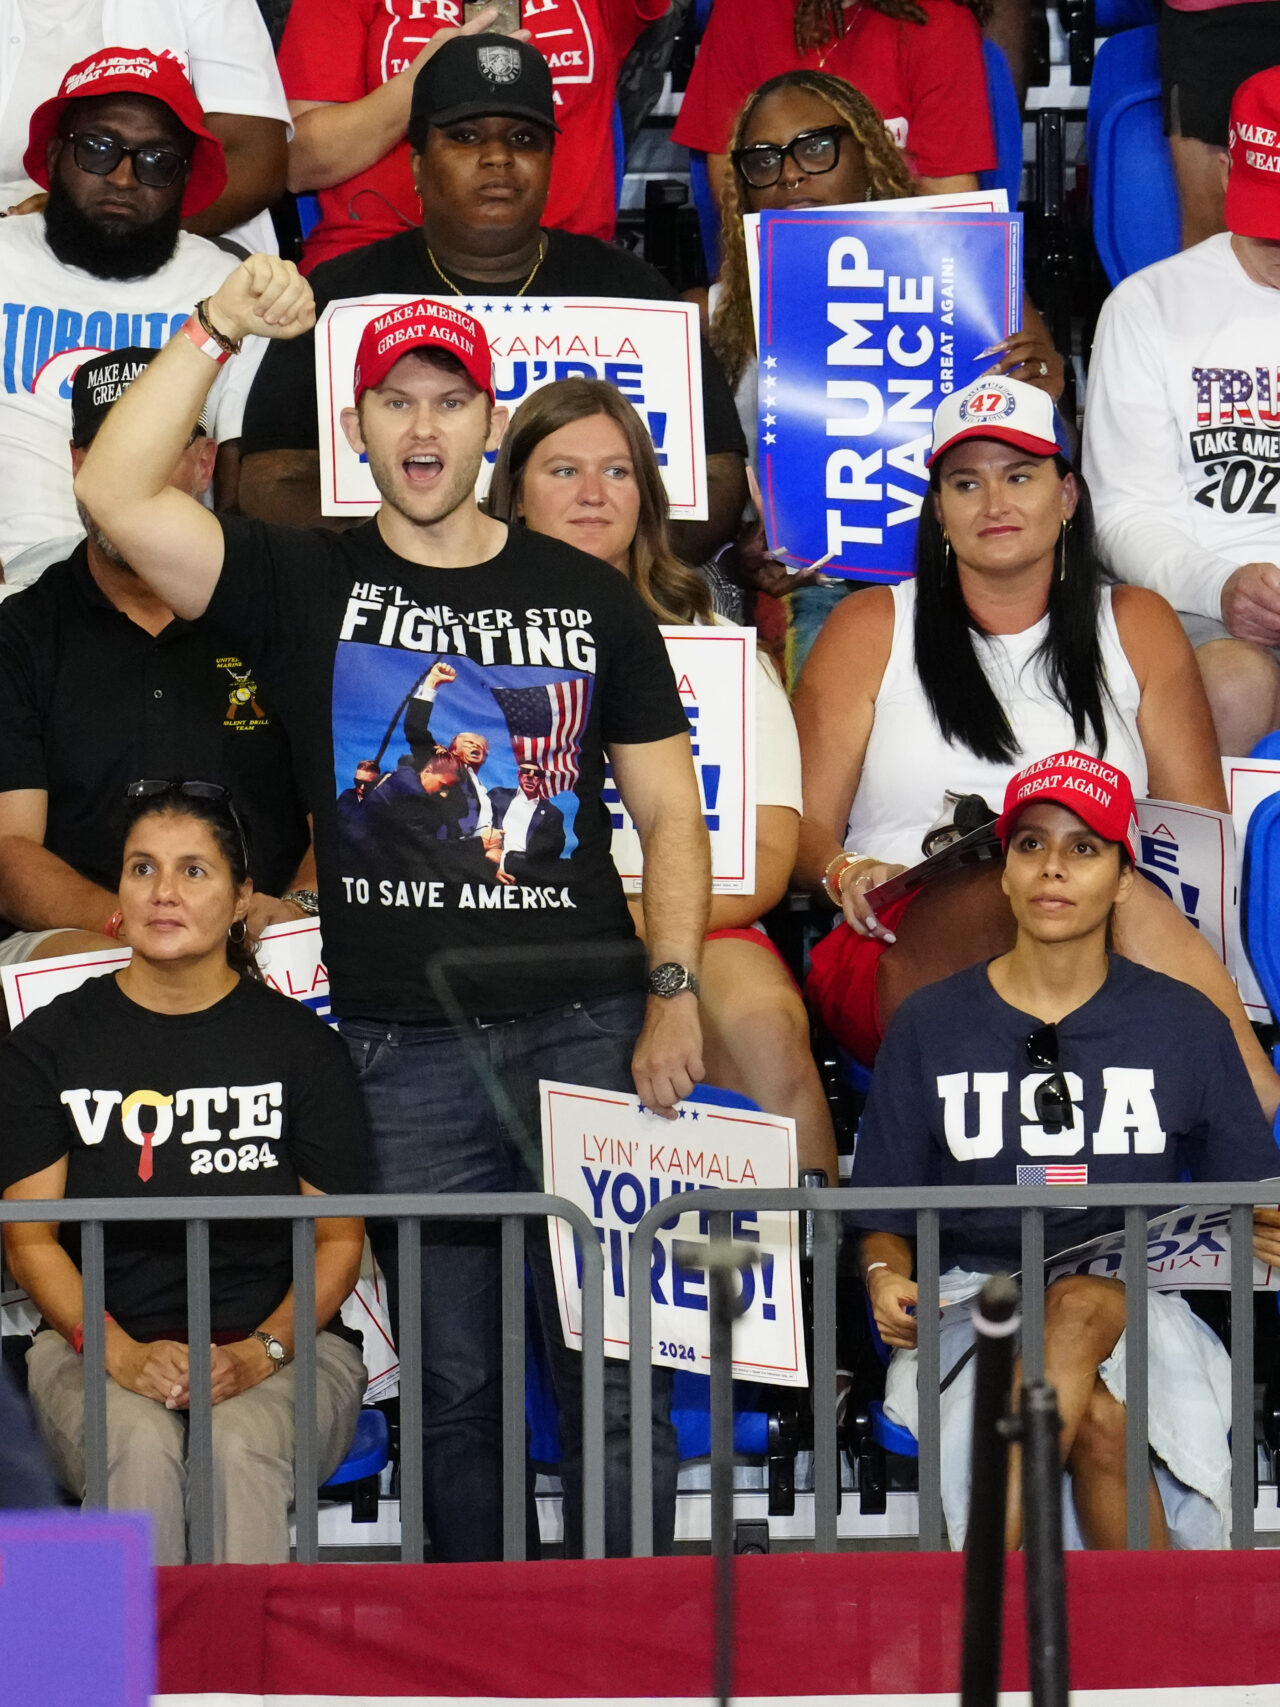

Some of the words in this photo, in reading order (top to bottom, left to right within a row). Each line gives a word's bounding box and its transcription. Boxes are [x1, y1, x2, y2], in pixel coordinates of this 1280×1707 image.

[544, 51, 584, 68] ACK
[1236, 122, 1278, 147] MAKE
[939, 256, 955, 326] AGAIN!
[374, 305, 414, 335] MAKE
[415, 303, 476, 338] AMERICA
[377, 324, 426, 355] GREAT
[429, 325, 474, 356] AGAIN
[87, 363, 120, 389] MAKE
[939, 332, 954, 395] GREAT
[825, 235, 884, 556] TRUMP
[886, 275, 935, 528] VANCE
[969, 393, 1002, 413] 47
[1193, 431, 1238, 457] TAKE
[525, 608, 593, 629] STOP
[1016, 756, 1055, 782] MAKE
[1055, 754, 1119, 790] AMERICA
[1017, 774, 1062, 801] GREAT
[1062, 776, 1112, 808] AGAIN
[341, 877, 369, 904] TO
[378, 880, 445, 908] SAVE
[458, 883, 577, 910] AMERICA
[60, 1081, 283, 1148] VOTE
[936, 1067, 1167, 1162] USA
[190, 1143, 279, 1175] 2024
[583, 1133, 639, 1168] LYIN'
[650, 1143, 758, 1186] KAMALA
[659, 1340, 696, 1362] 2024
